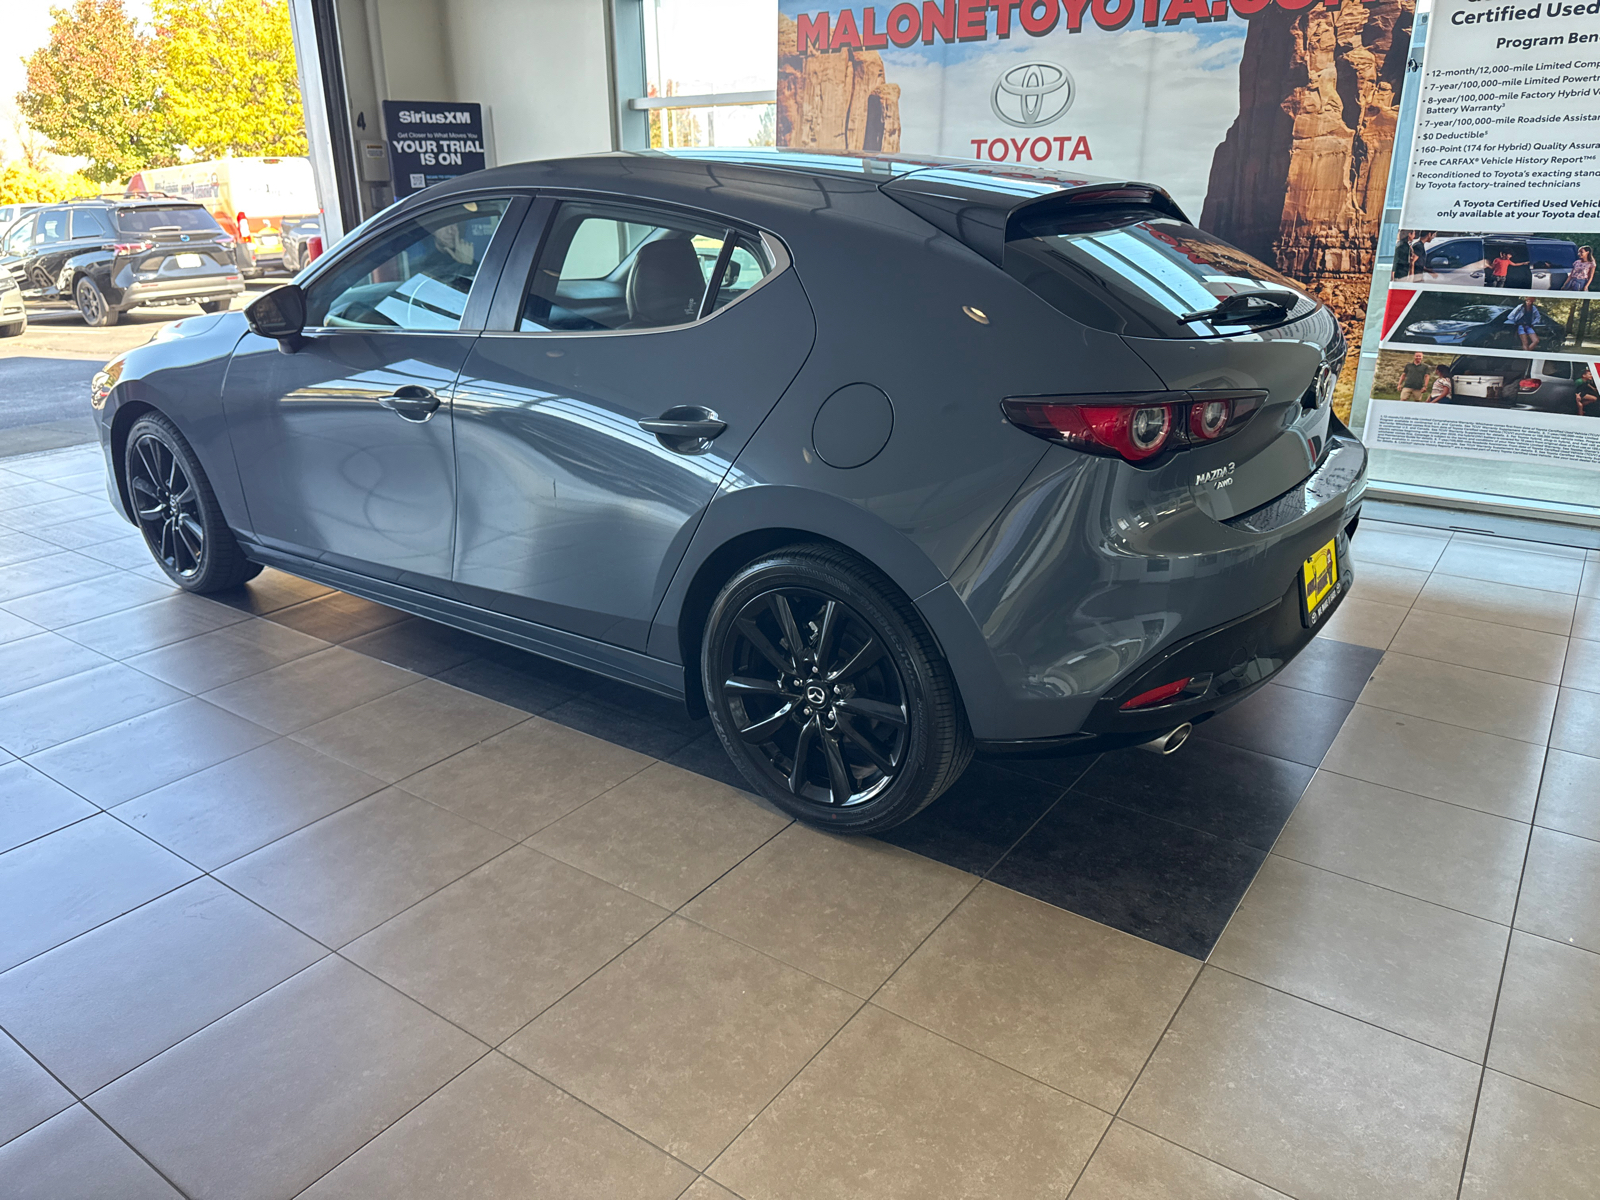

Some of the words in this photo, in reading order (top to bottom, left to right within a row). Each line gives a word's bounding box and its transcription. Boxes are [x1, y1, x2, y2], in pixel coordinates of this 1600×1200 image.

[1451, 3, 1542, 25] Certified
[1546, 0, 1600, 17] Used
[797, 0, 1376, 54] MALONETOYOTA.
[1496, 35, 1564, 50] Program
[1568, 32, 1600, 44] Ben
[1432, 63, 1534, 77] 12-month/12,000-mile
[1536, 61, 1573, 71] Limited
[1430, 77, 1522, 92] 7-year/100,000-mile
[1524, 76, 1561, 85] Limited
[1427, 92, 1519, 105] 8-year/100,000-mile
[1520, 91, 1556, 99] Factory
[1557, 88, 1591, 99] Hybrid
[399, 111, 471, 124] SiriusXM
[1426, 107, 1459, 115] Battery
[357, 111, 366, 130] 4
[1424, 116, 1516, 129] 7-year/100,000-mile
[1517, 114, 1561, 124] Roadside
[1422, 132, 1434, 141] $0
[392, 140, 438, 153] YOUR
[439, 140, 484, 153] TRIAL
[970, 136, 1093, 162] TOYOTA
[1421, 145, 1462, 153] 160-Point
[1463, 144, 1482, 153] (174
[1497, 142, 1532, 152] Hybrid)
[1533, 142, 1567, 151] Quality
[420, 153, 436, 165] IS
[438, 153, 462, 165] ON
[1481, 157, 1513, 165] Vehicle
[1515, 156, 1549, 165] History
[1531, 170, 1572, 178] exacting
[1415, 181, 1426, 190] by
[1428, 181, 1457, 190] Toyota
[1458, 180, 1526, 189] factory-trained
[1527, 180, 1581, 188] technicians
[1453, 200, 1461, 208] A
[1463, 200, 1495, 209] Toyota
[1496, 199, 1541, 208] Certified
[1542, 199, 1569, 208] Used
[1436, 210, 1458, 219] only
[1459, 210, 1503, 218] available
[1516, 211, 1540, 220] your
[1541, 210, 1575, 220] Toyota
